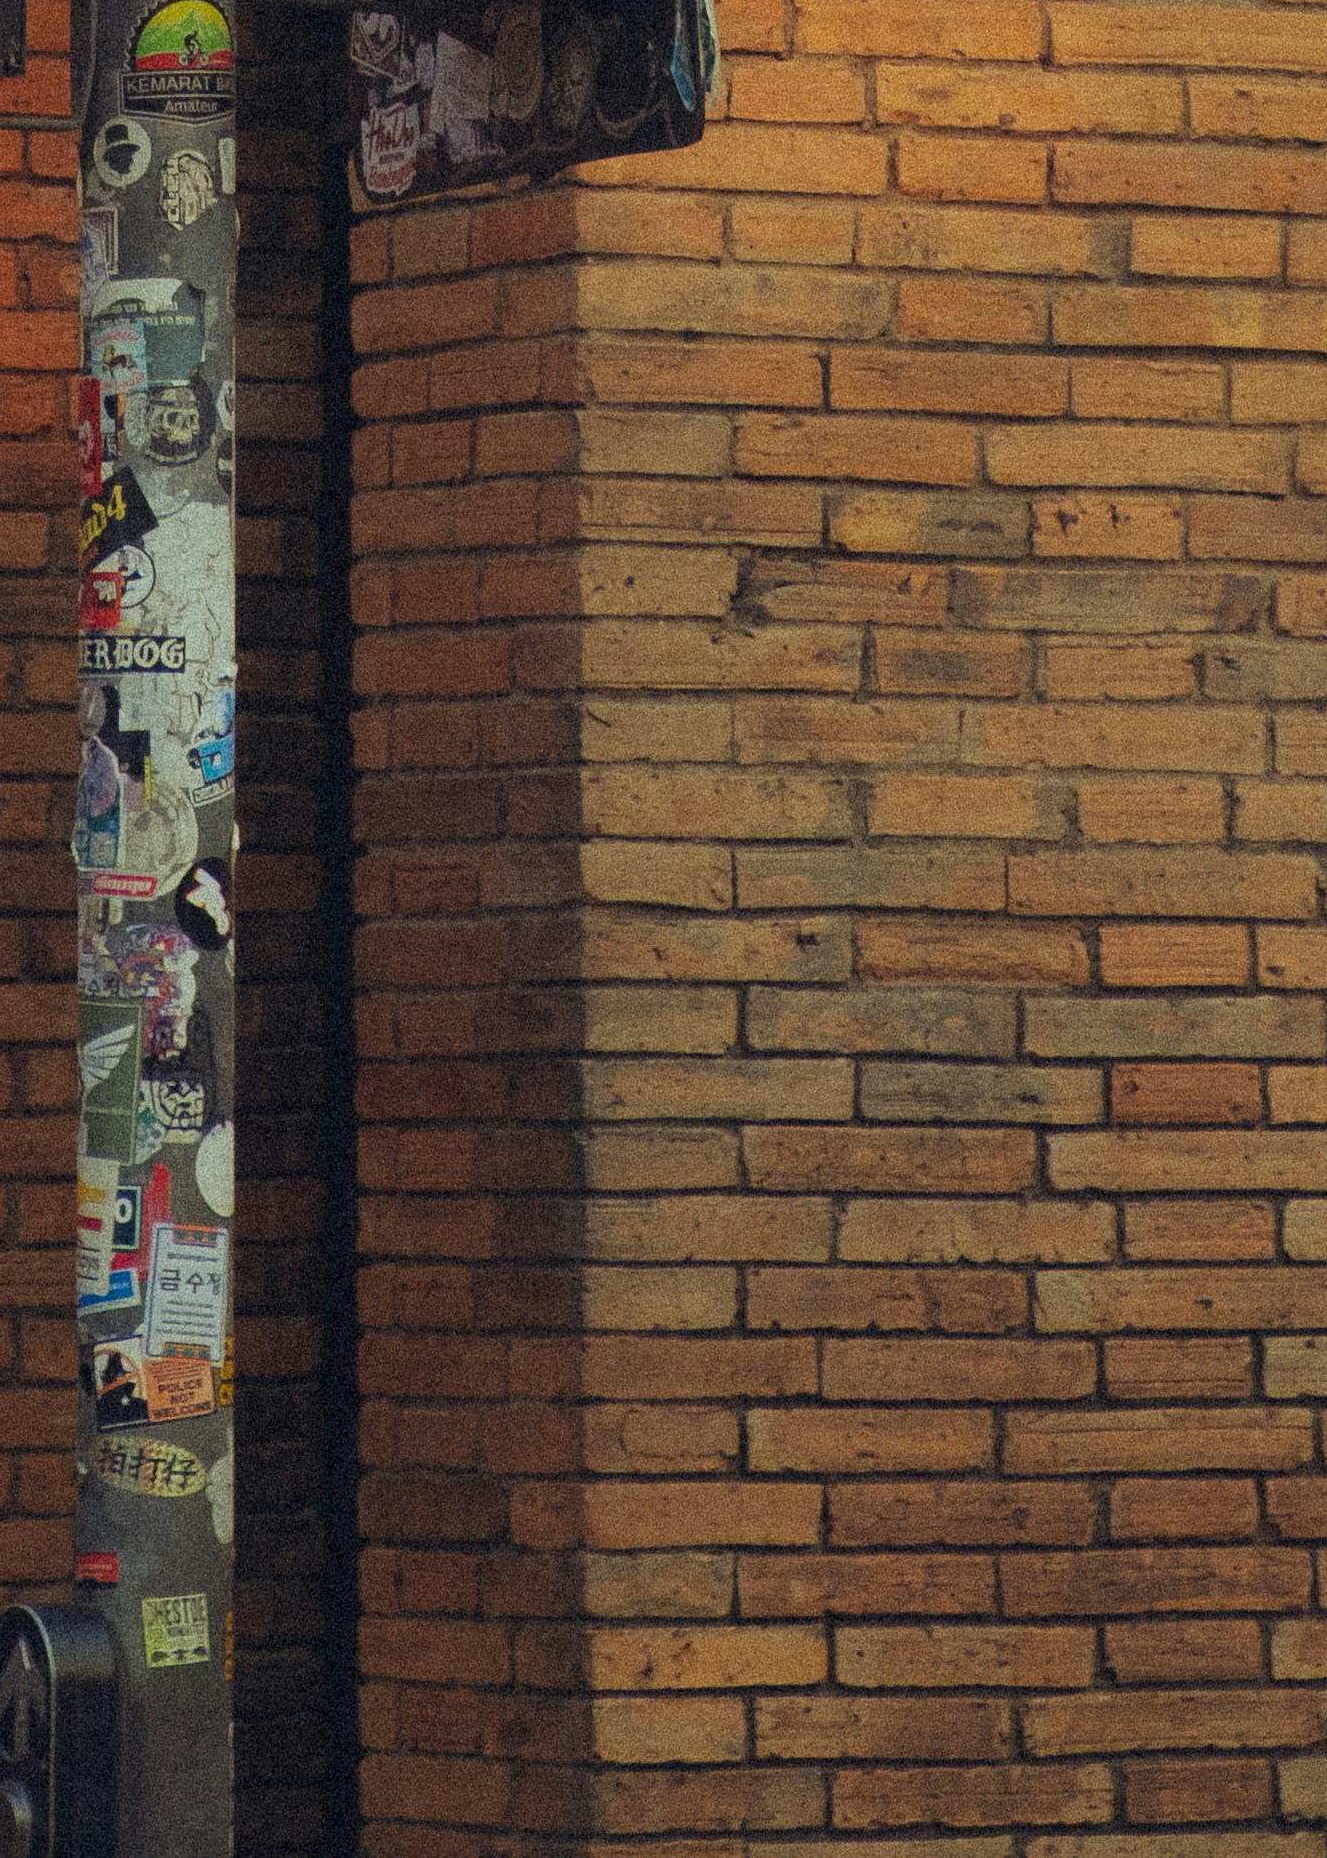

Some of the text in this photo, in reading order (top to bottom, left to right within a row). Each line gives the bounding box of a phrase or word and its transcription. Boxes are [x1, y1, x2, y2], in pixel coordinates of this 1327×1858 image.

[126, 75, 211, 93] KEMARAT
[163, 100, 218, 114] Amateur
[158, 1378, 203, 1393] POLICE
[169, 1391, 195, 1404] NOT
[153, 1400, 211, 1419] WELCOME
